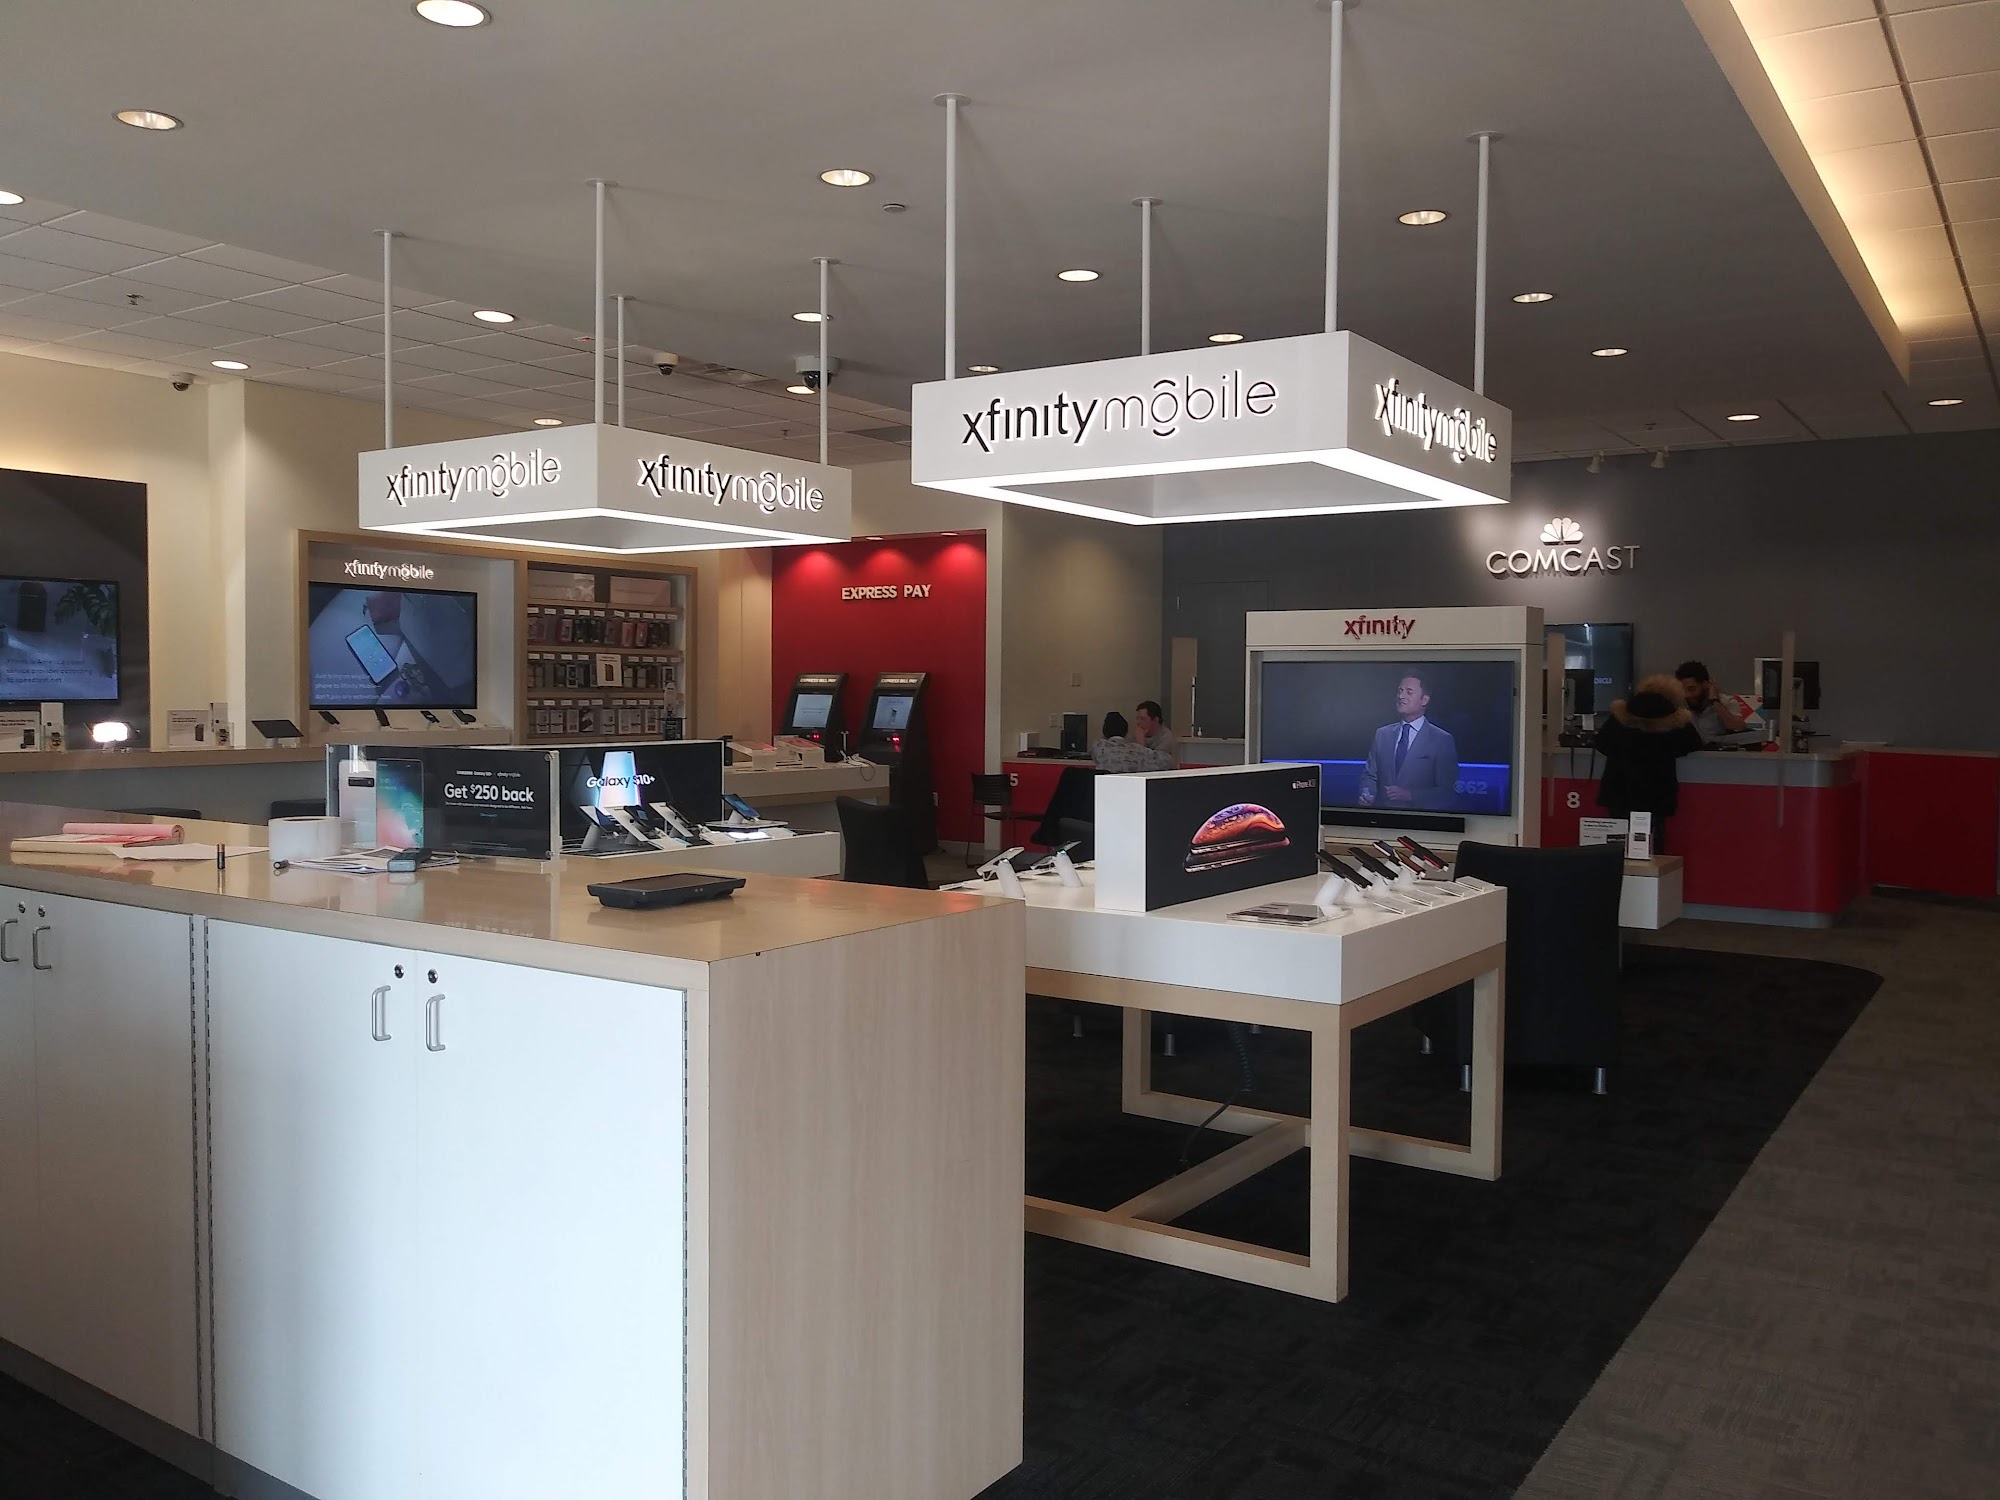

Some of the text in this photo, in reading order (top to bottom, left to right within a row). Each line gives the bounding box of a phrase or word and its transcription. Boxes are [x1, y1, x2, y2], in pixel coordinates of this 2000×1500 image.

[1485, 545, 1640, 575] COMCAST
[841, 584, 932, 600] EXPRESS PAY
[1344, 615, 1416, 640] xfinity
[586, 774, 656, 788] Galaxy S10+
[1009, 772, 1019, 787] 5
[444, 783, 535, 803] Get $250 back
[1566, 791, 1581, 809] 8
